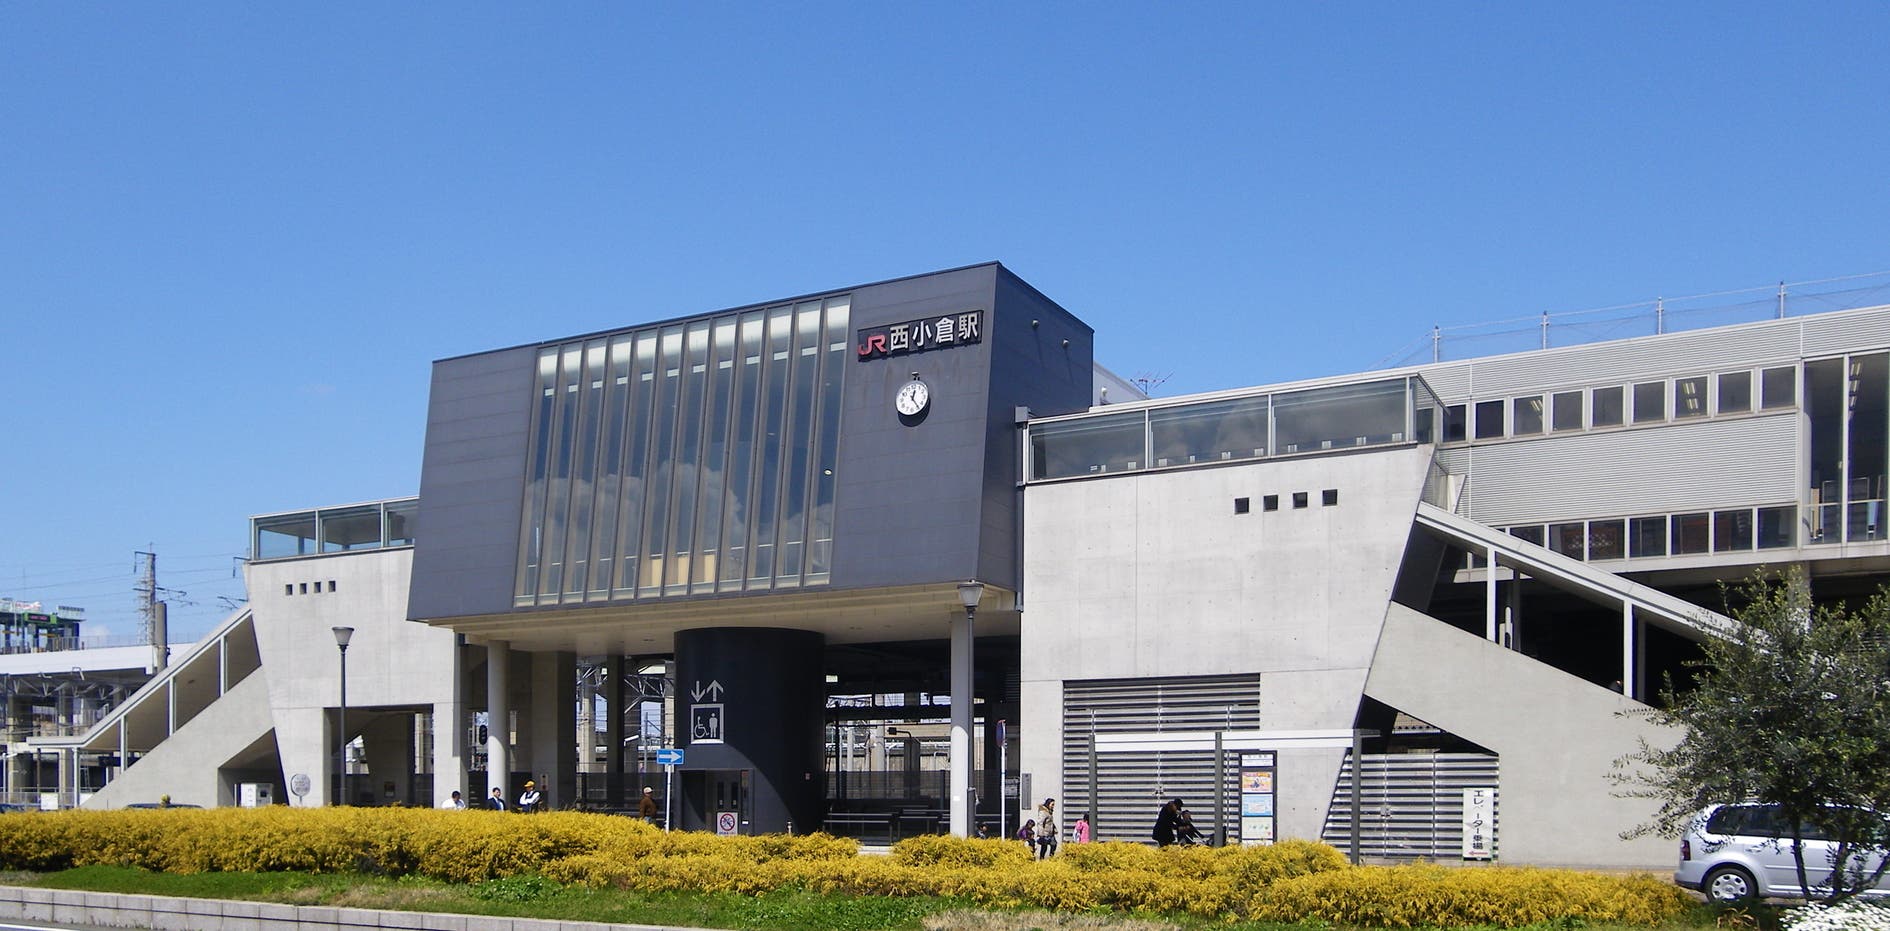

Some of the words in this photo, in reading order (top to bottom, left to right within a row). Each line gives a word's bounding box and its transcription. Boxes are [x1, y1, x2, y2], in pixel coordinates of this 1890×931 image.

[857, 334, 887, 356] JR
[890, 312, 979, 351] 西小倉駅
